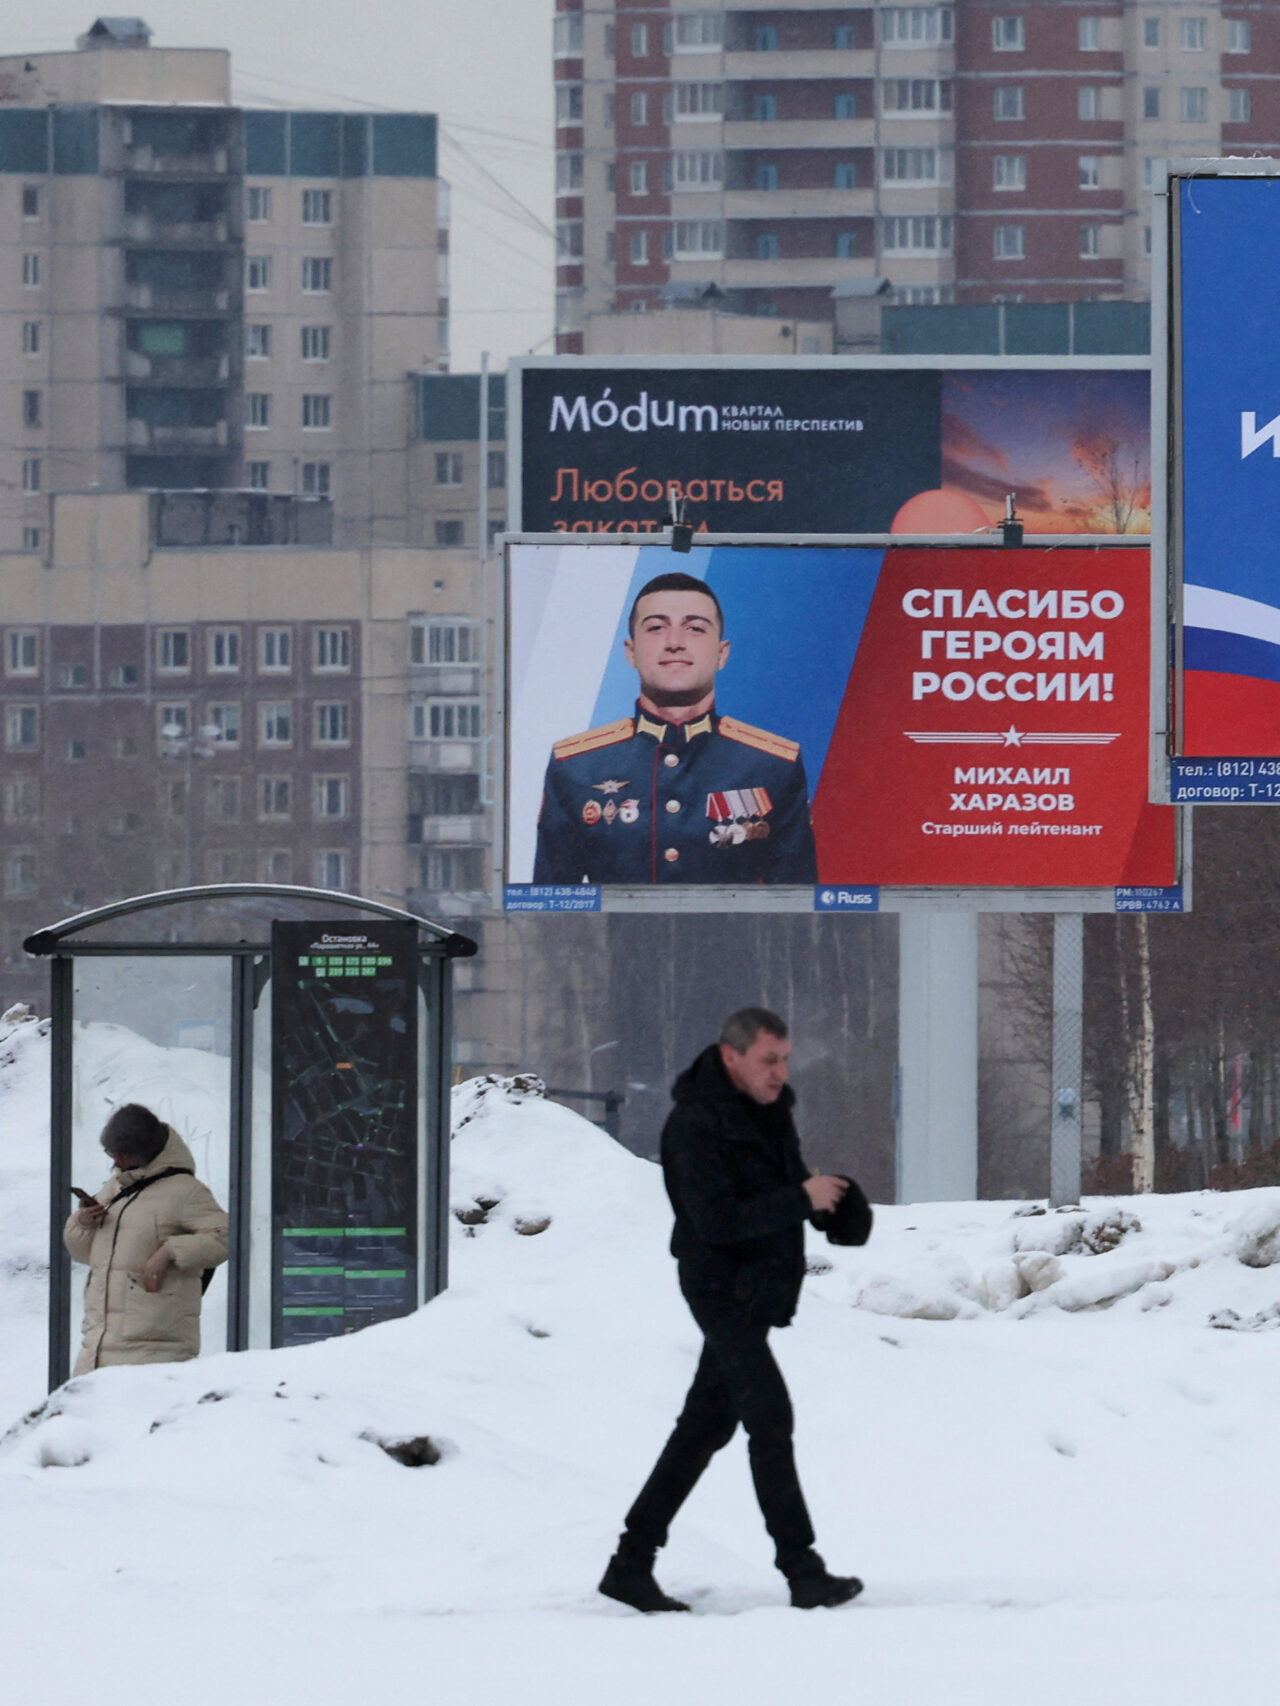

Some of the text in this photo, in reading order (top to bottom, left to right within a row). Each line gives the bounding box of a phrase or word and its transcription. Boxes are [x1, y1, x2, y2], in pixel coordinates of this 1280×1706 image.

[550, 388, 718, 432] Módum
[722, 406, 782, 416] КВАРТАЛ
[722, 420, 863, 431] НОВЫХ ПЕРСПЕКТИВ
[550, 467, 784, 502] Любоваться
[903, 589, 1124, 619] СПАСИБО
[922, 631, 1103, 660] ГЕРОЯМ
[913, 672, 1113, 701] РОССИИ!
[955, 767, 1069, 785] МИХАИЛ
[1177, 766, 1212, 776] тел.:
[1218, 762, 1254, 776] (812)
[1177, 787, 1244, 800] договор:
[950, 794, 1074, 811] ХАРАЗОВ
[922, 822, 1102, 837] Старший лейтенант
[838, 892, 872, 904] Russ
[1172, 901, 1180, 909] A
